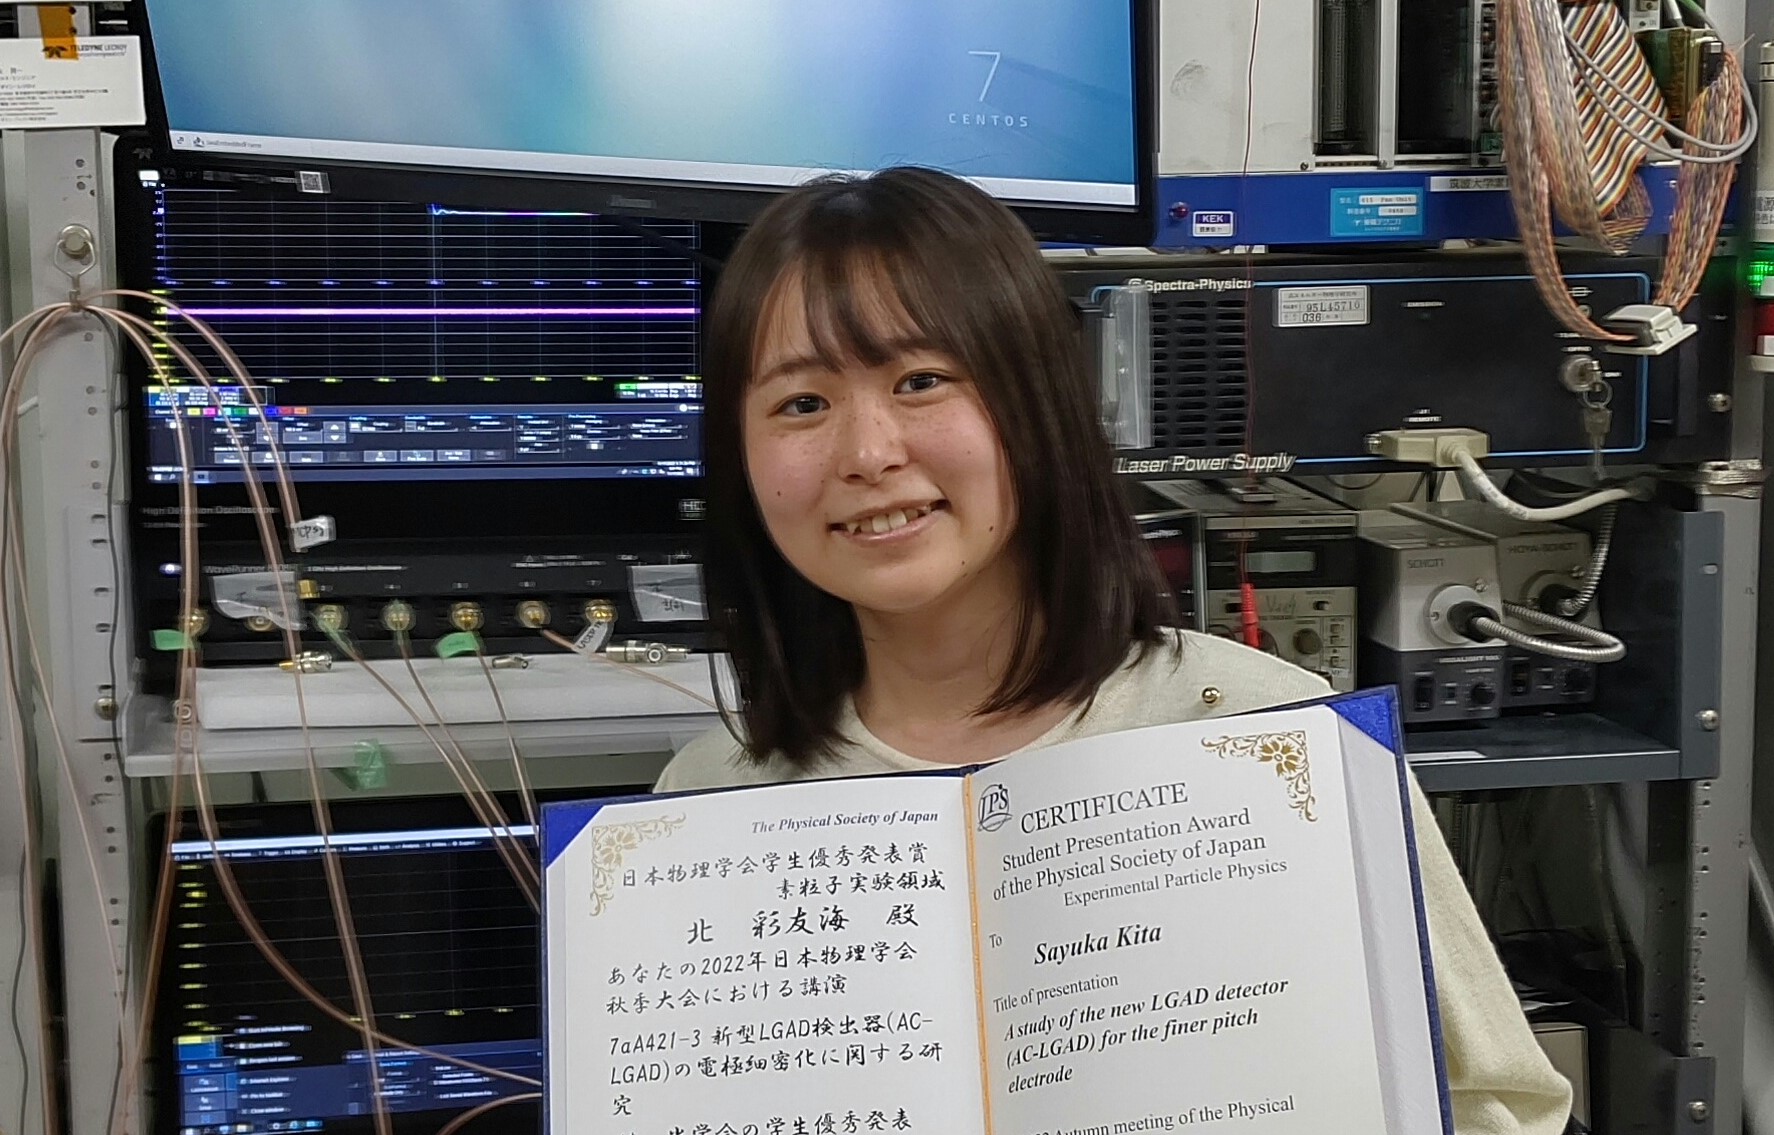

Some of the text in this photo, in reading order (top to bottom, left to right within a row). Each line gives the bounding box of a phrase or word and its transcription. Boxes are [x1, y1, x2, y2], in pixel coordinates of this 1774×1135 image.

[949, 113, 1028, 127] CENTOS
[1202, 214, 1224, 223] KEK
[1302, 313, 1321, 323] 036
[1116, 452, 1296, 473] Laser Power Supply
[1407, 558, 1444, 568] SCHOTT
[753, 810, 937, 833] The Physical Society of Japan
[1021, 782, 1187, 834] CERTIFICATE
[1002, 807, 1250, 871] Student Presentation Award
[623, 841, 928, 887] 日本物理学会学生優秀発表賞
[776, 868, 945, 900] 素粒子実験領域
[993, 836, 1266, 900] of the Physical Society of Japan
[1064, 861, 1287, 906] Experimental Particle Physics
[687, 903, 918, 944] 北 彩友海 殿
[988, 933, 1002, 948] To
[607, 940, 917, 986] あなたの2022年日本物理学会
[1034, 923, 1161, 965] Sayuka Kita
[606, 973, 846, 1015] 秋季大会における講演
[993, 974, 1118, 1012] Title of presentation
[1004, 980, 1288, 1041] A study of the new LGAD detector
[1004, 1007, 1257, 1070] (AC-LGAD) for the finer pitch
[1008, 1064, 1072, 1093] electrode
[613, 1094, 631, 1115] 究
[1113, 1113, 1174, 1134] meeting
[1178, 1107, 1196, 1124] of
[1199, 1105, 1222, 1122] the
[1227, 1094, 1294, 1119] Physical
